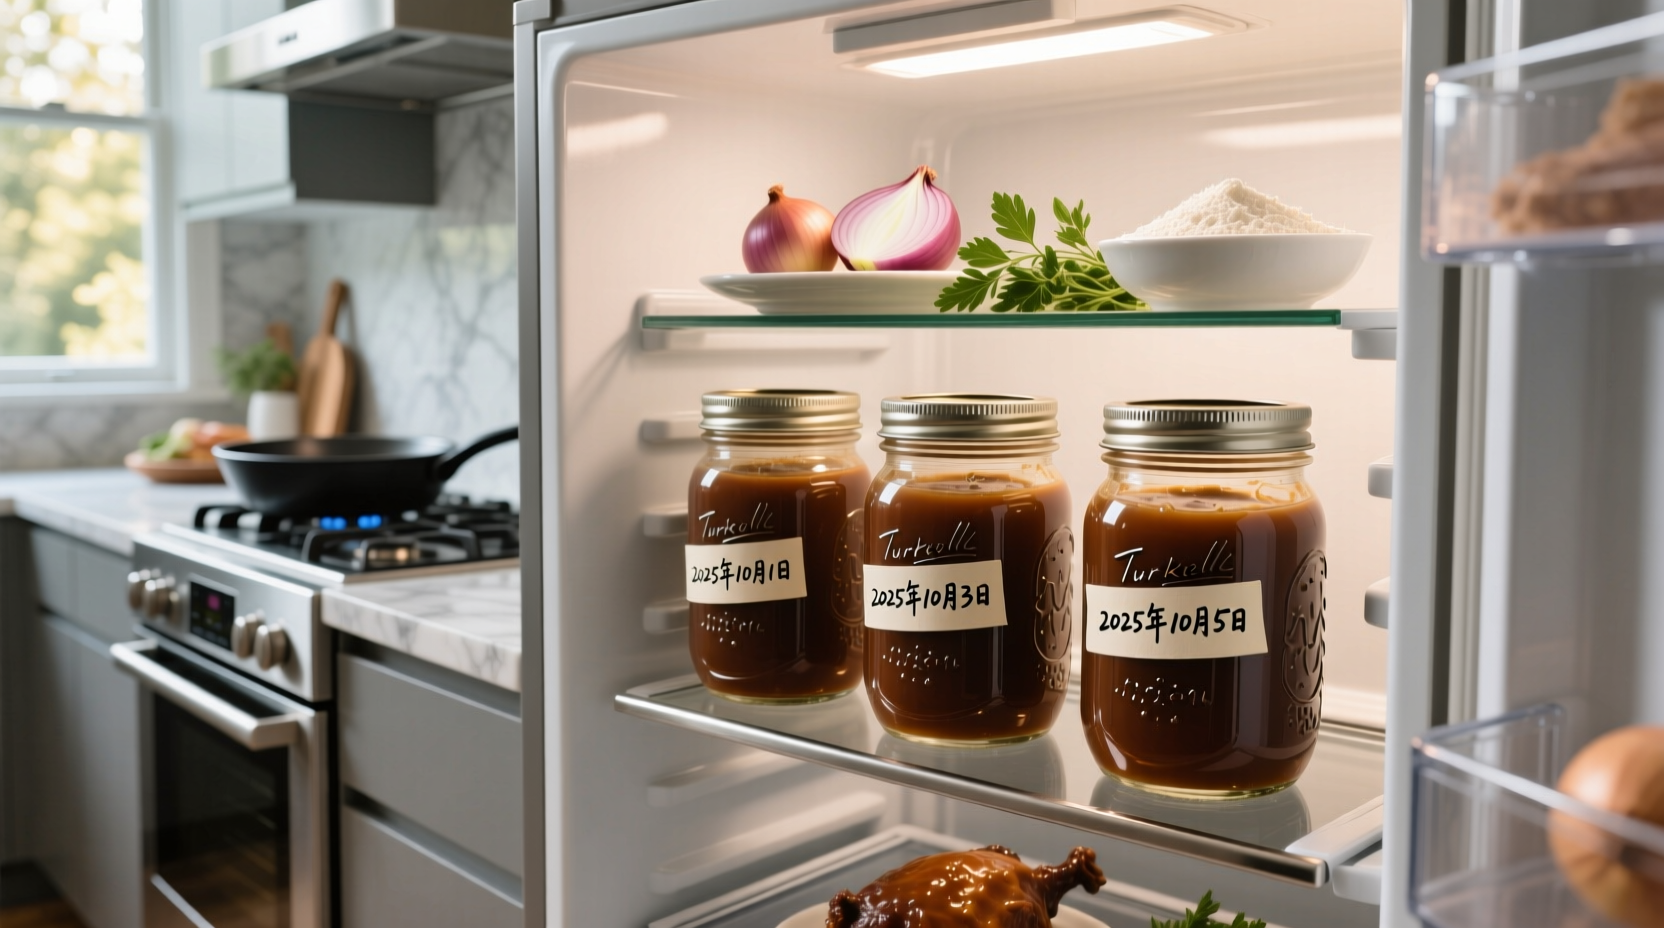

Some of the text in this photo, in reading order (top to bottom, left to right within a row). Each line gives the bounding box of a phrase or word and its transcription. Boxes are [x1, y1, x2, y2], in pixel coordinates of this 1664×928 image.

[691, 558, 790, 591] 2025年10月1日
[871, 580, 990, 617] 2025年10月3日
[1099, 603, 1246, 644] 2025年10月5日
